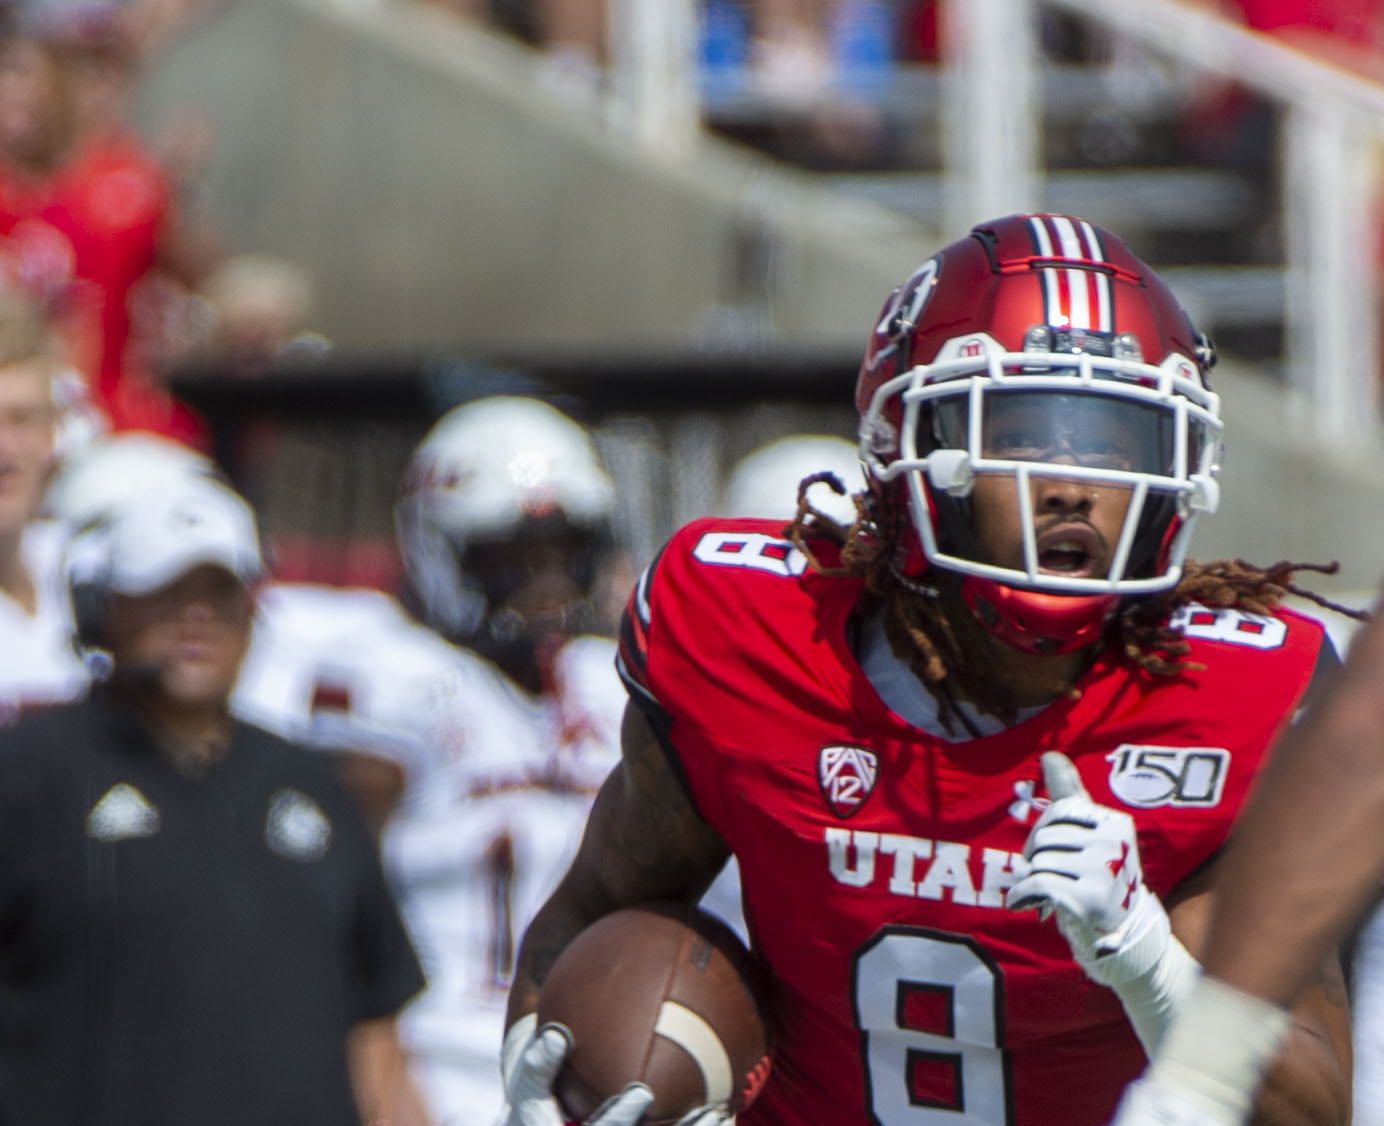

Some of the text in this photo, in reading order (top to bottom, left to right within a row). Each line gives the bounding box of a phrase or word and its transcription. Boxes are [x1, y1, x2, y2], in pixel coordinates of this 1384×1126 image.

[693, 532, 809, 577] 8
[820, 746, 878, 793] PAC
[831, 775, 862, 804] 12
[824, 827, 1032, 910] UTAH
